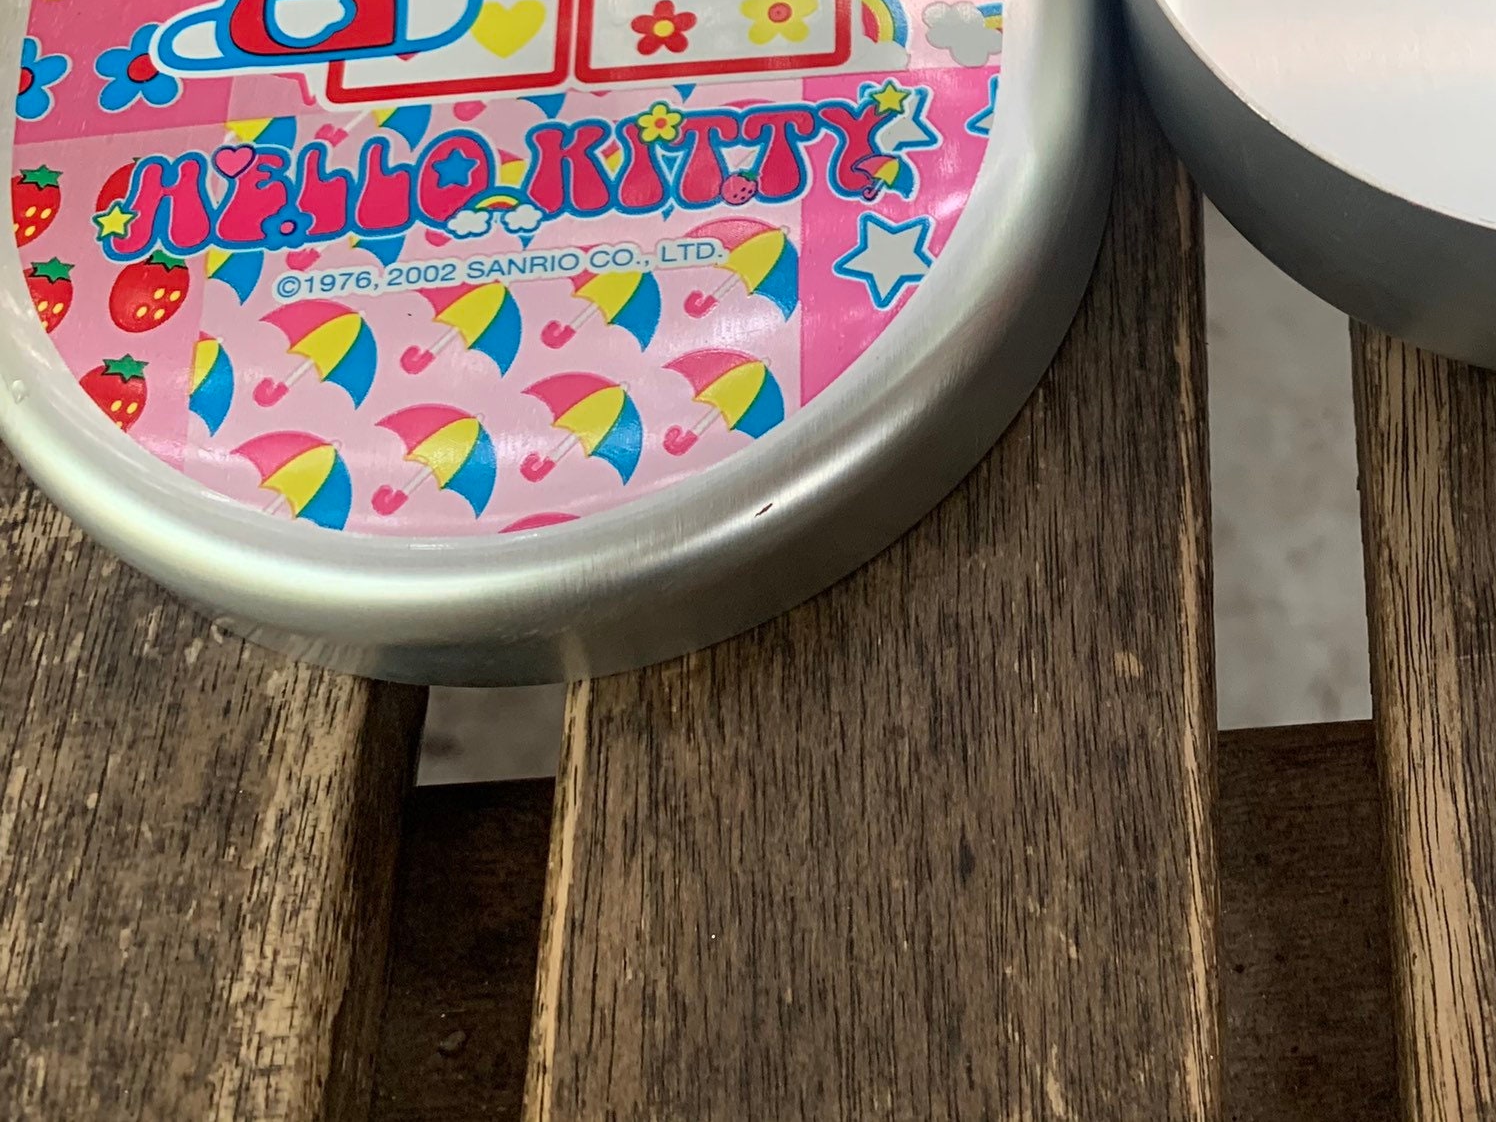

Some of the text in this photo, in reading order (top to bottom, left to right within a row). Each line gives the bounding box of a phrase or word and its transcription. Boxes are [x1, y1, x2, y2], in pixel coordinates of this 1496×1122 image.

[100, 98, 906, 258] HELLO KITTY
[276, 242, 724, 298] ©1976, 2002 SANRIO CO., LTD.
